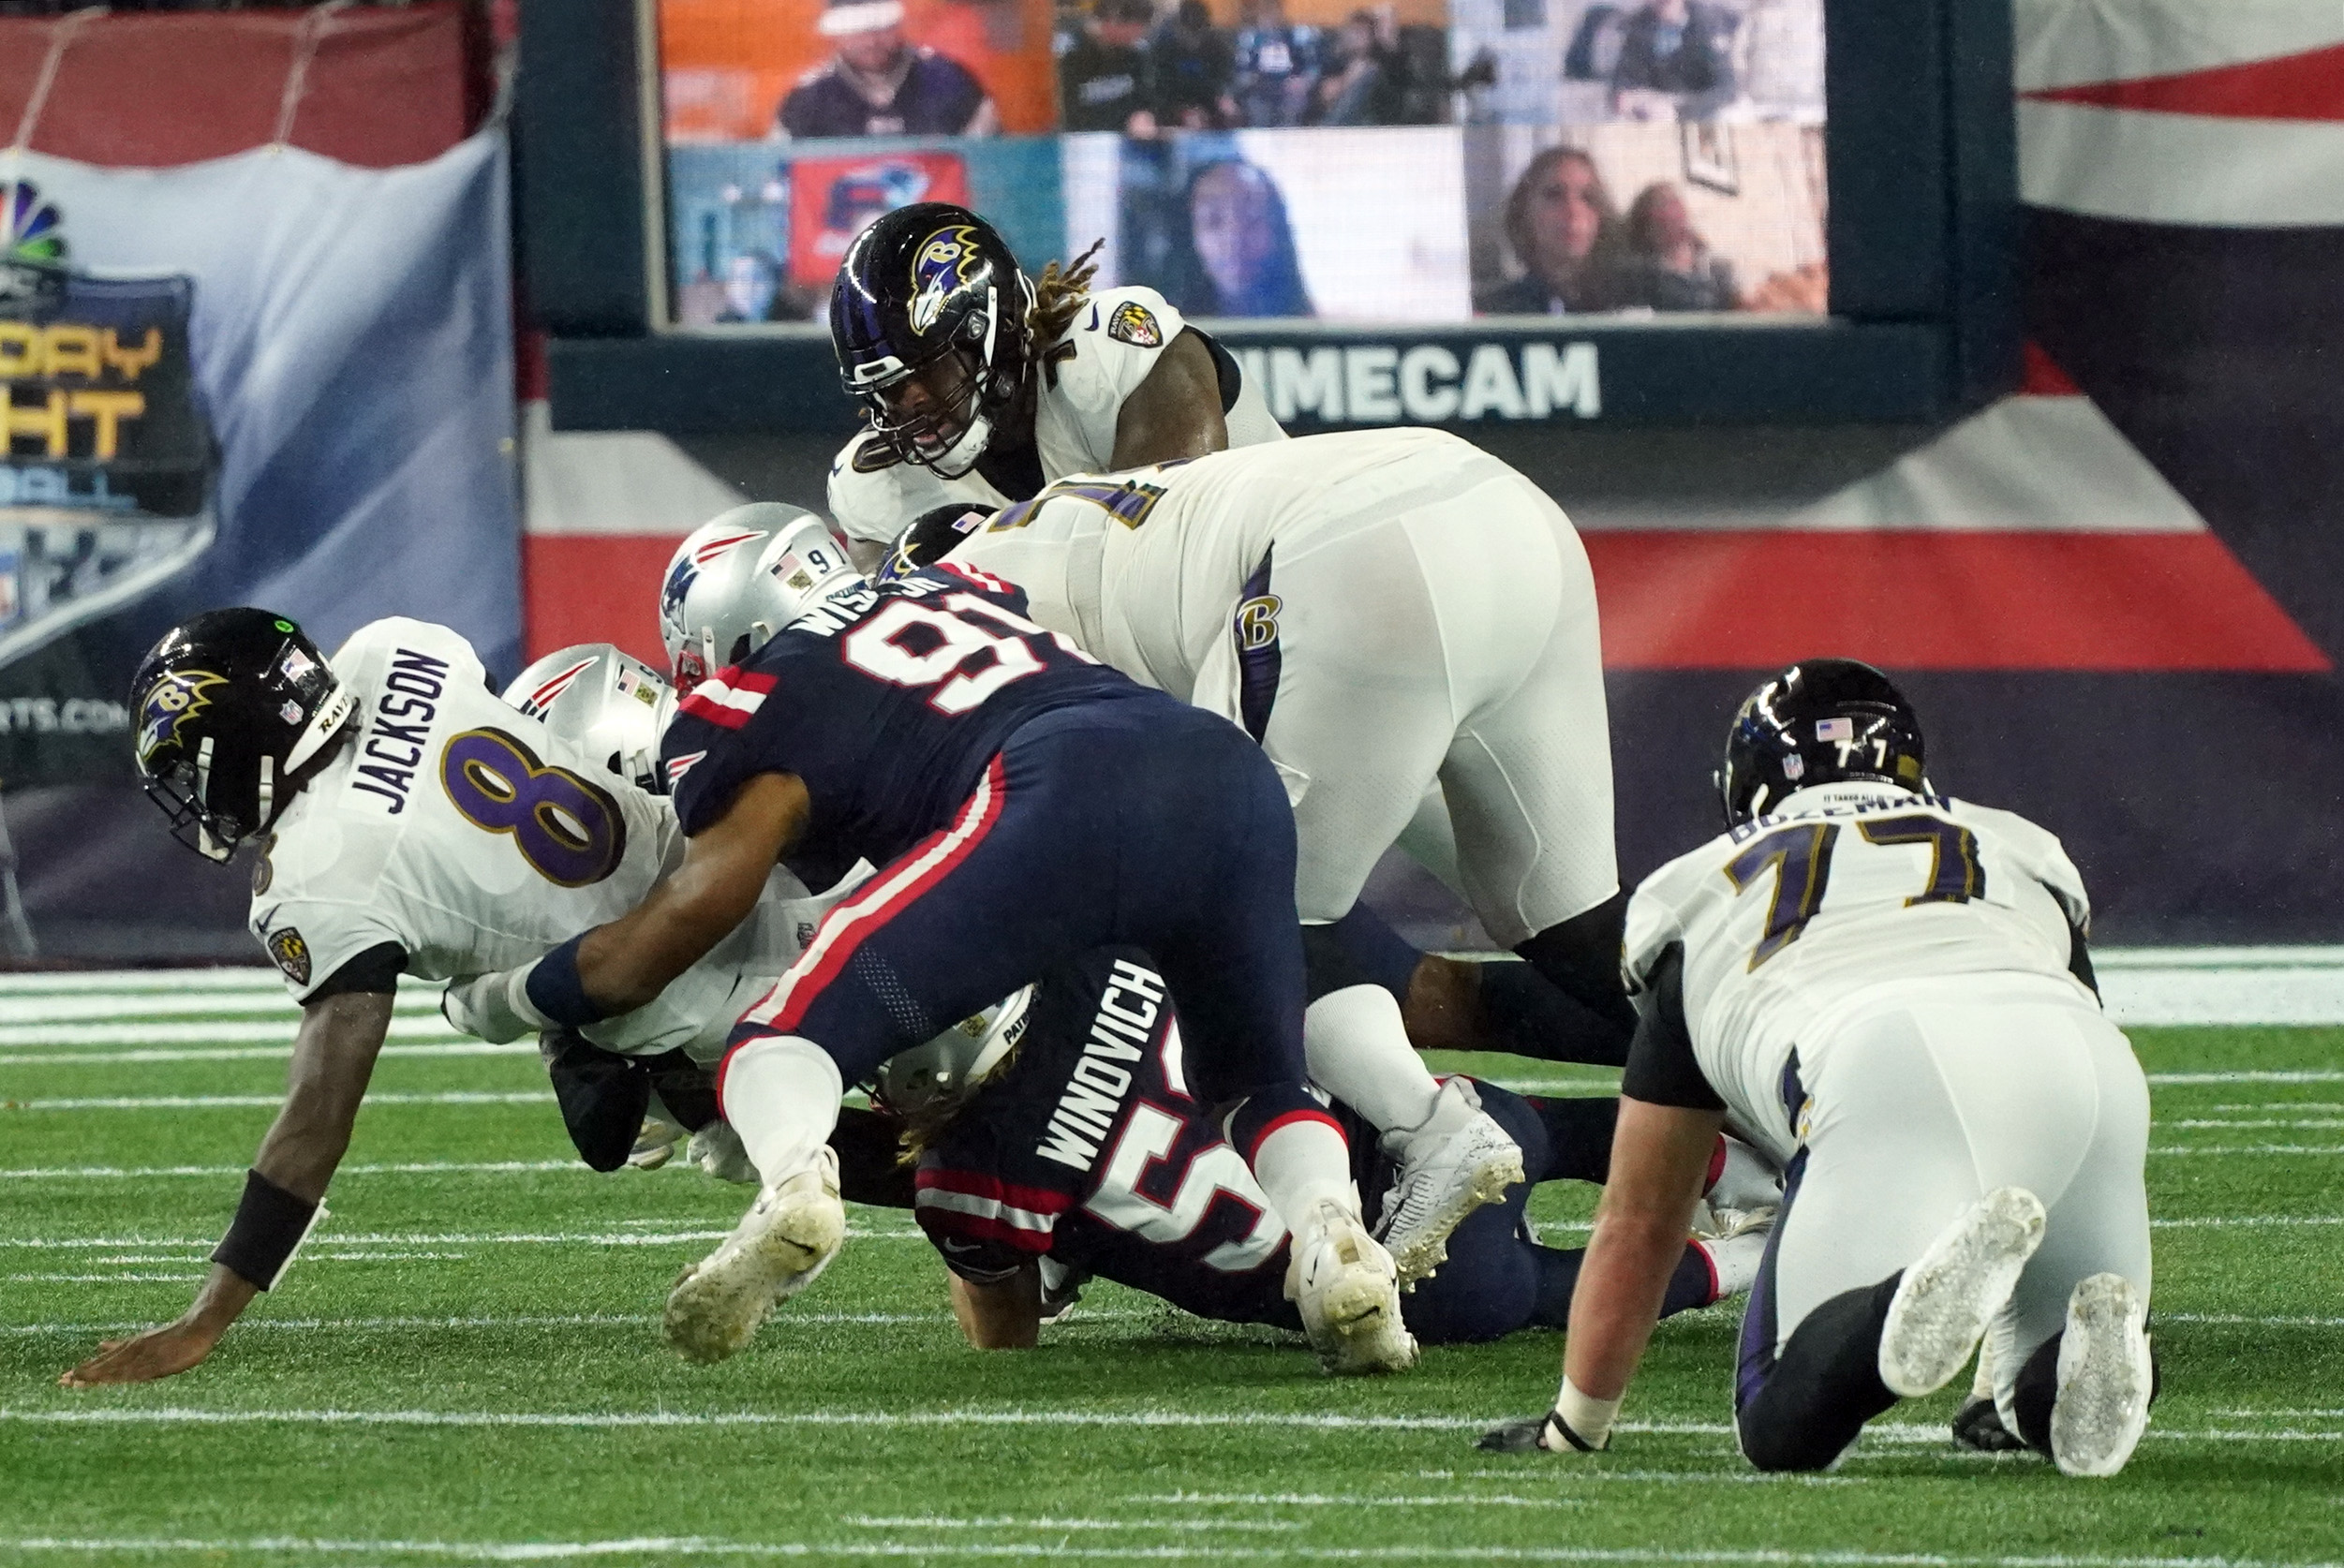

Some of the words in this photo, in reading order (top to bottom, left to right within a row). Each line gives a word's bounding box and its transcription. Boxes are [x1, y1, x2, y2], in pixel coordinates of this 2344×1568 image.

[351, 647, 450, 815] JACKSON
[438, 726, 626, 889] 8
[1833, 738, 1888, 769] 77
[1722, 813, 1987, 975] 77
[1036, 958, 1166, 1172] WINOVICH
[1081, 1012, 1293, 1274] 5
